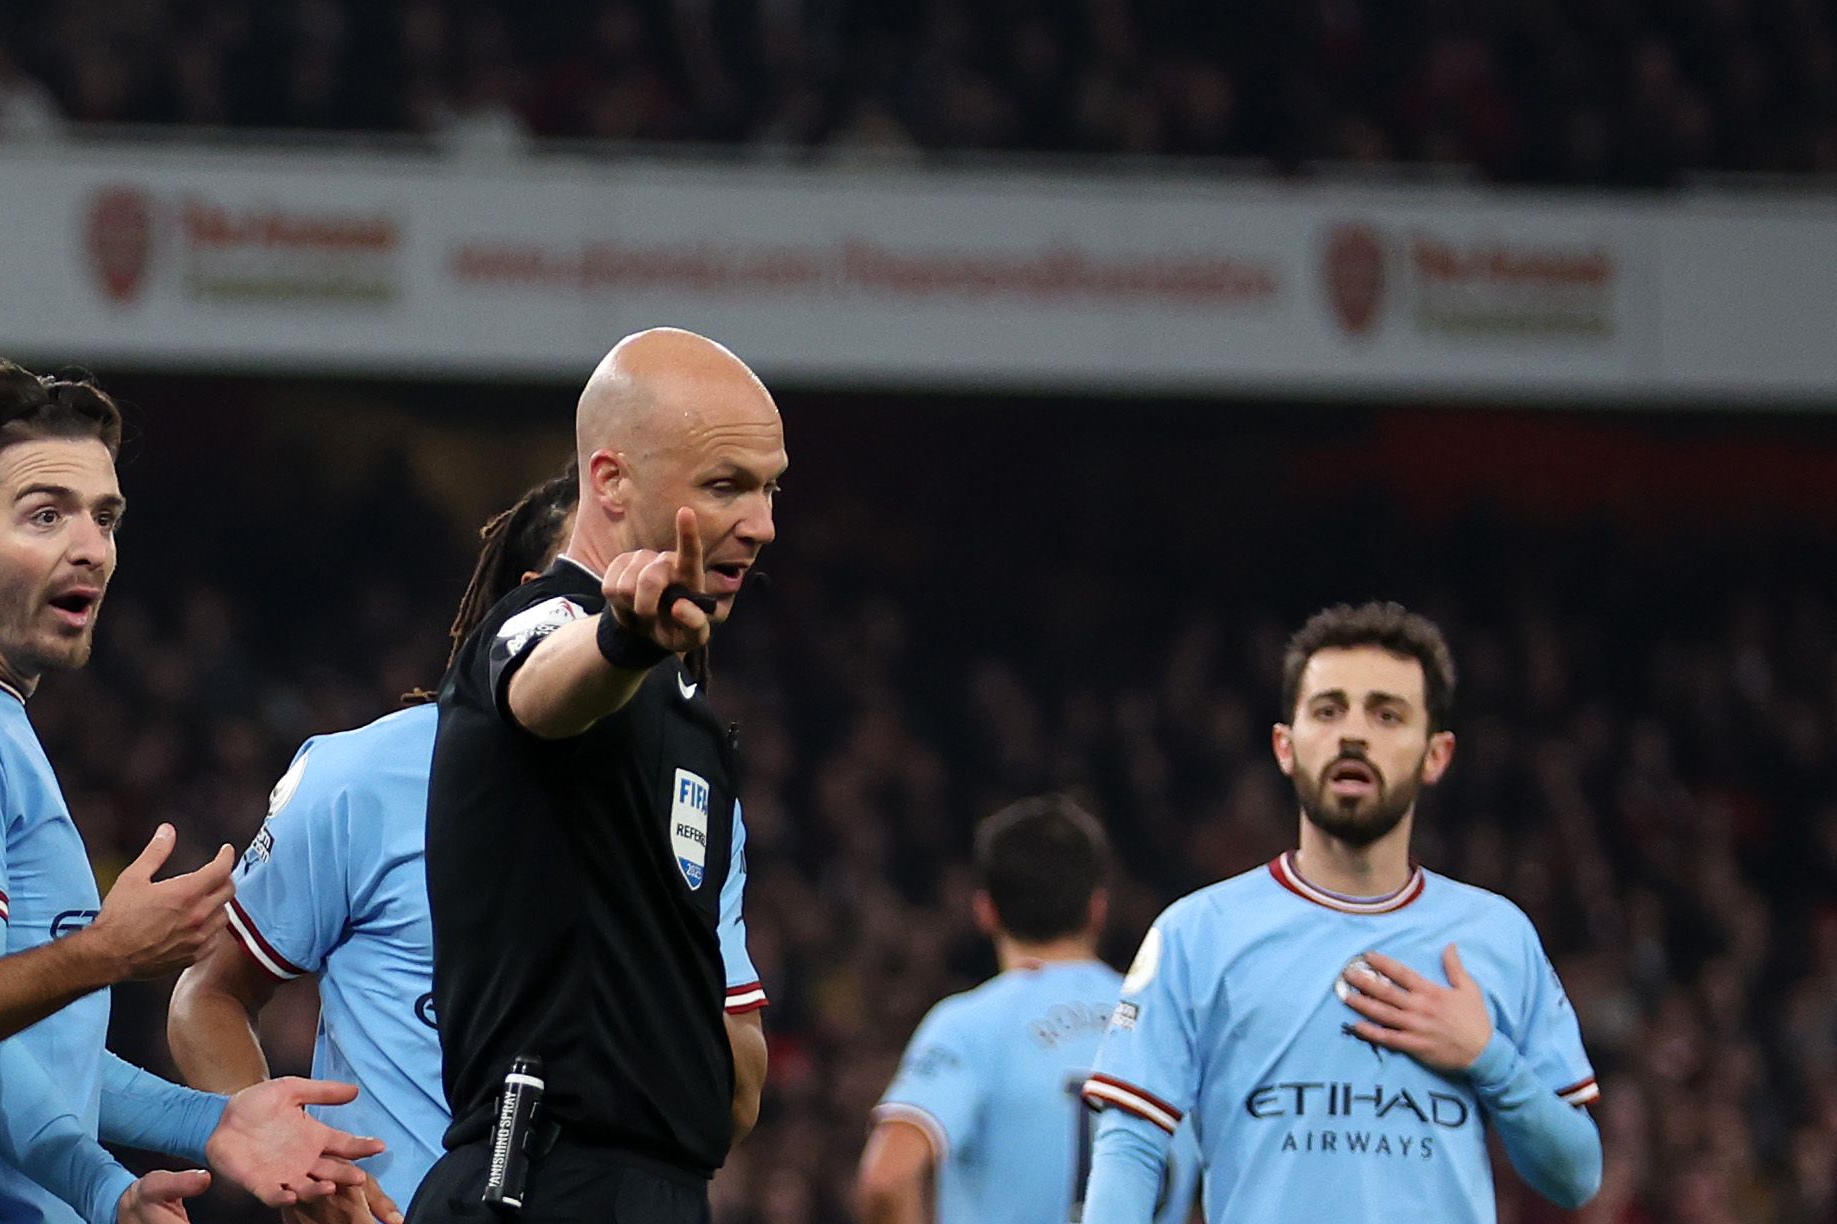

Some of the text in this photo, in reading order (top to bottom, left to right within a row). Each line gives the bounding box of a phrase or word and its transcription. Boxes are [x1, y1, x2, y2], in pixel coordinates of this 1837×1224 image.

[499, 1090, 517, 1128] SPRAY
[1245, 1081, 1469, 1129] ETIHAD
[1281, 1130, 1434, 1159] AIRWAYS
